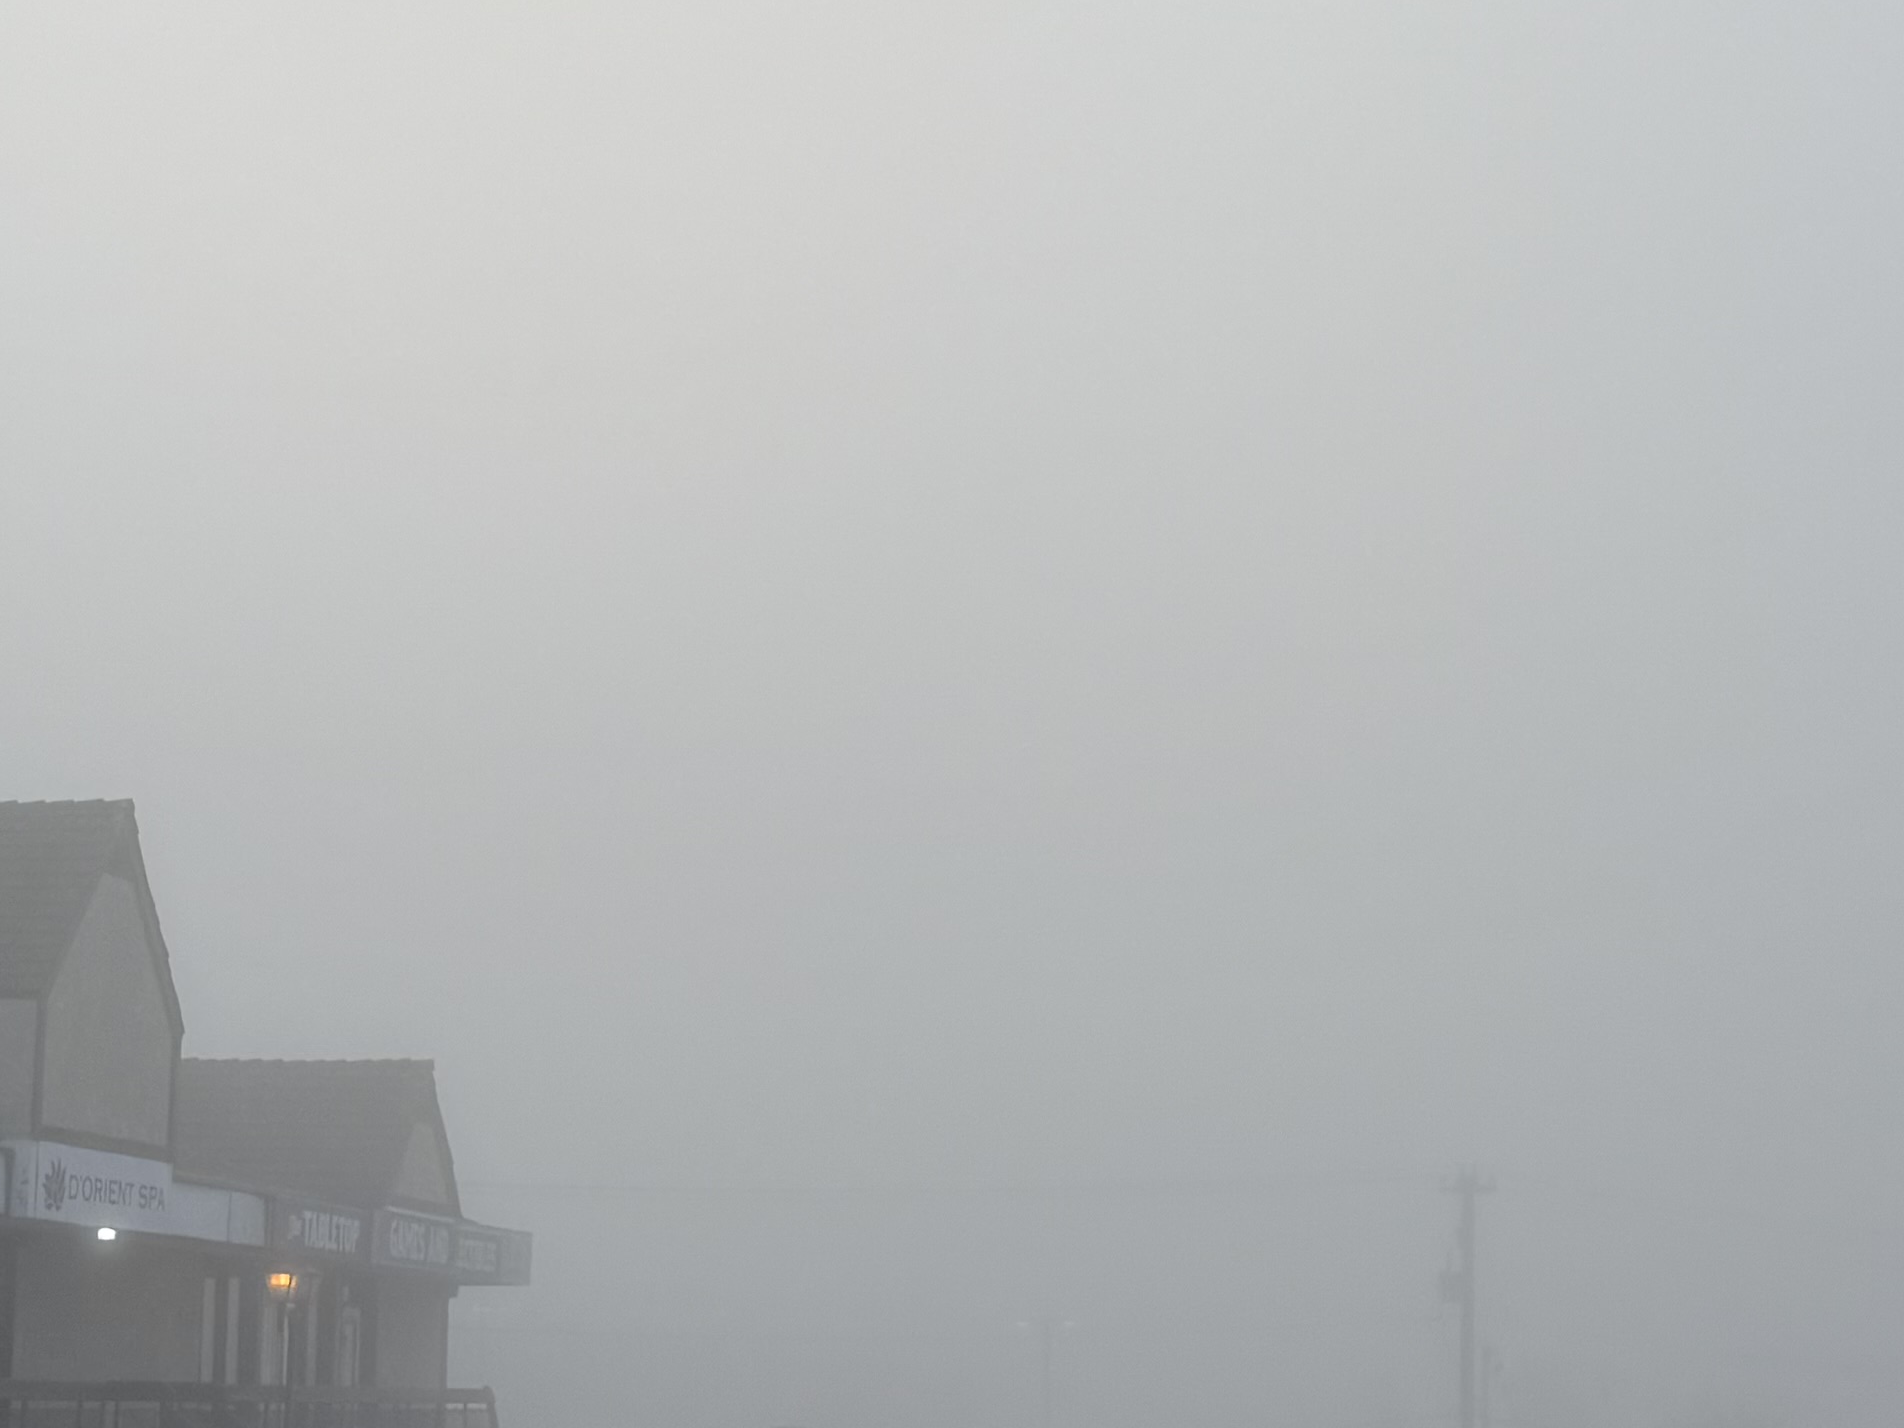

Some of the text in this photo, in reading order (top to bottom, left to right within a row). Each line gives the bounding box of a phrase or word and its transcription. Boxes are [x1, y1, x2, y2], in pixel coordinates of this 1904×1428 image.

[68, 1174, 166, 1212] D'ORIENT SPA
[303, 1210, 361, 1254] TABLETOP
